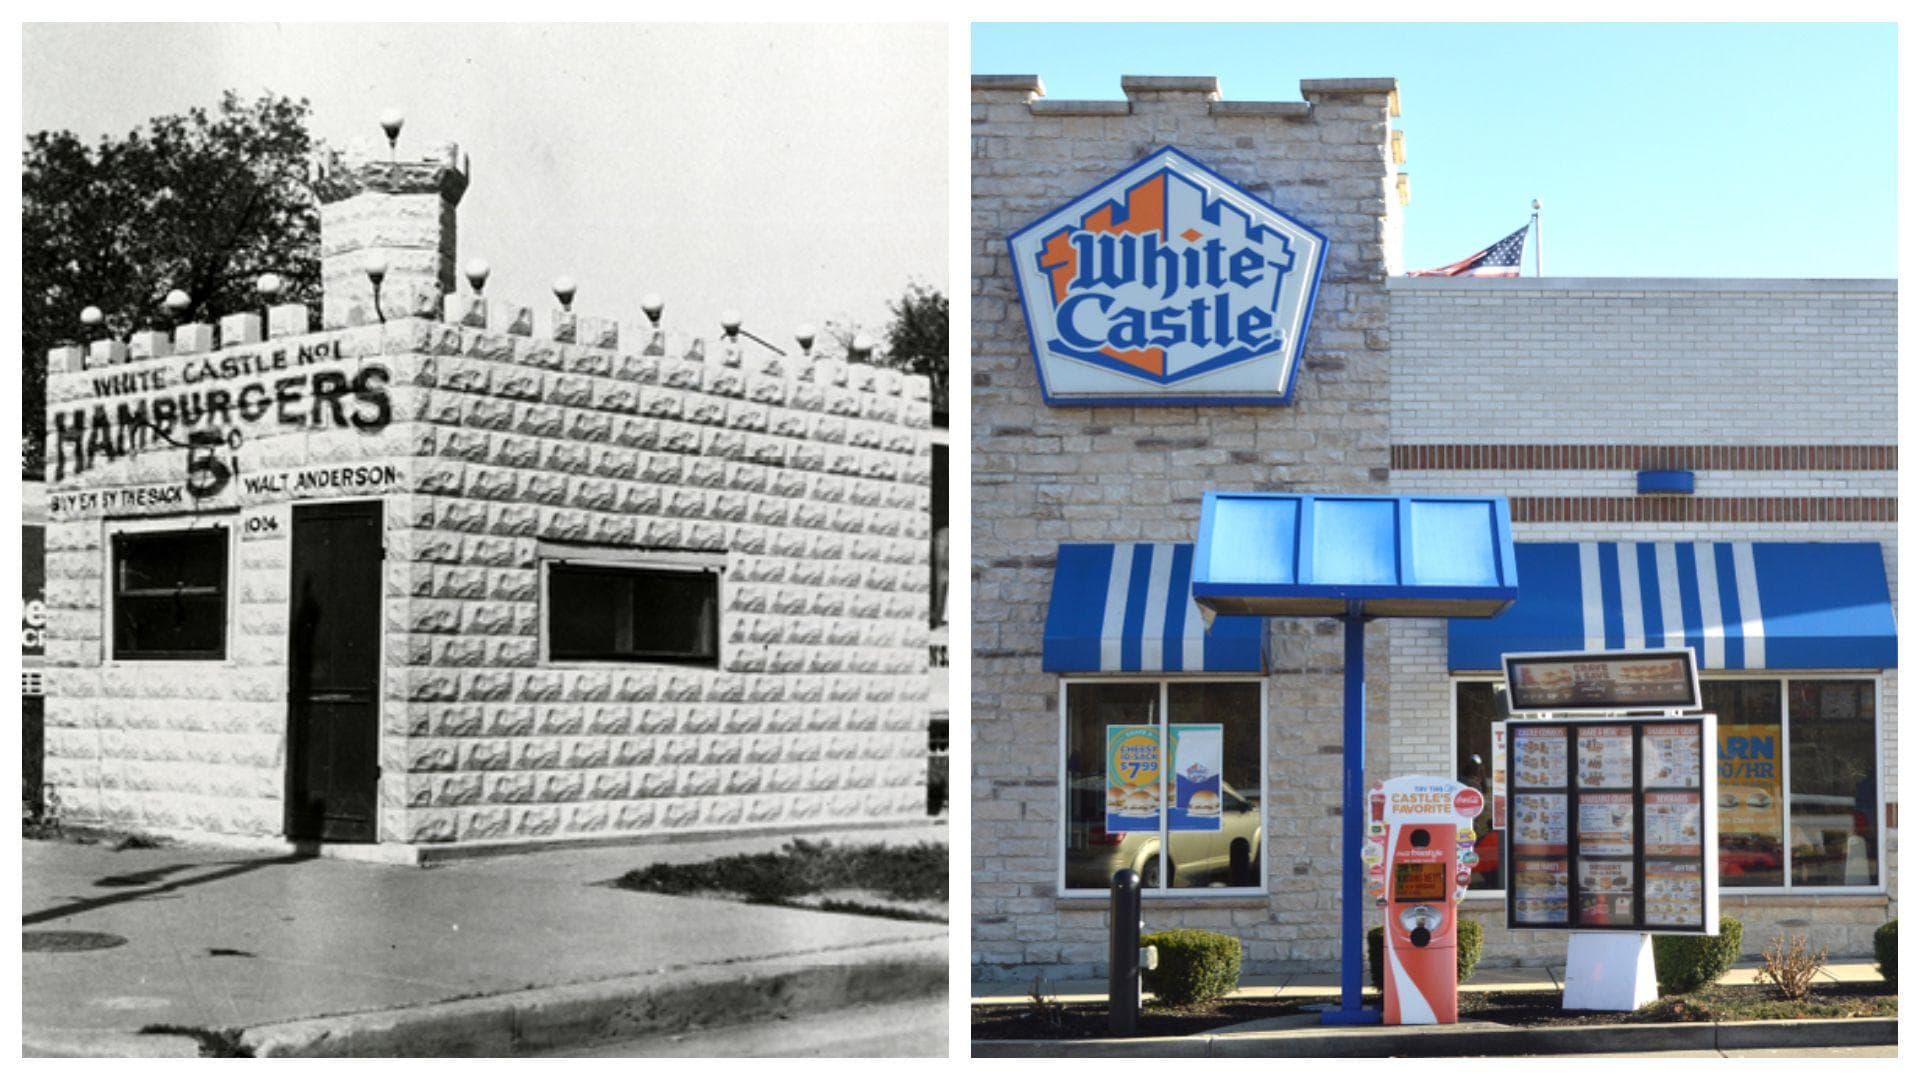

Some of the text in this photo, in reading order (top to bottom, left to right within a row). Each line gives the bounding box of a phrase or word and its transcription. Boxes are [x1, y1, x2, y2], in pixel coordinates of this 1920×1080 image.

[1068, 233, 1265, 300] White
[1056, 293, 1273, 349] Castle
[92, 370, 167, 398] WHITE
[182, 348, 287, 385] CASTLE
[54, 366, 392, 482] HAMBURGERS
[244, 466, 396, 494] WALT ANDERSON
[1391, 793, 1451, 803] CASTLE'S
[1391, 804, 1451, 814] FAVORITE
